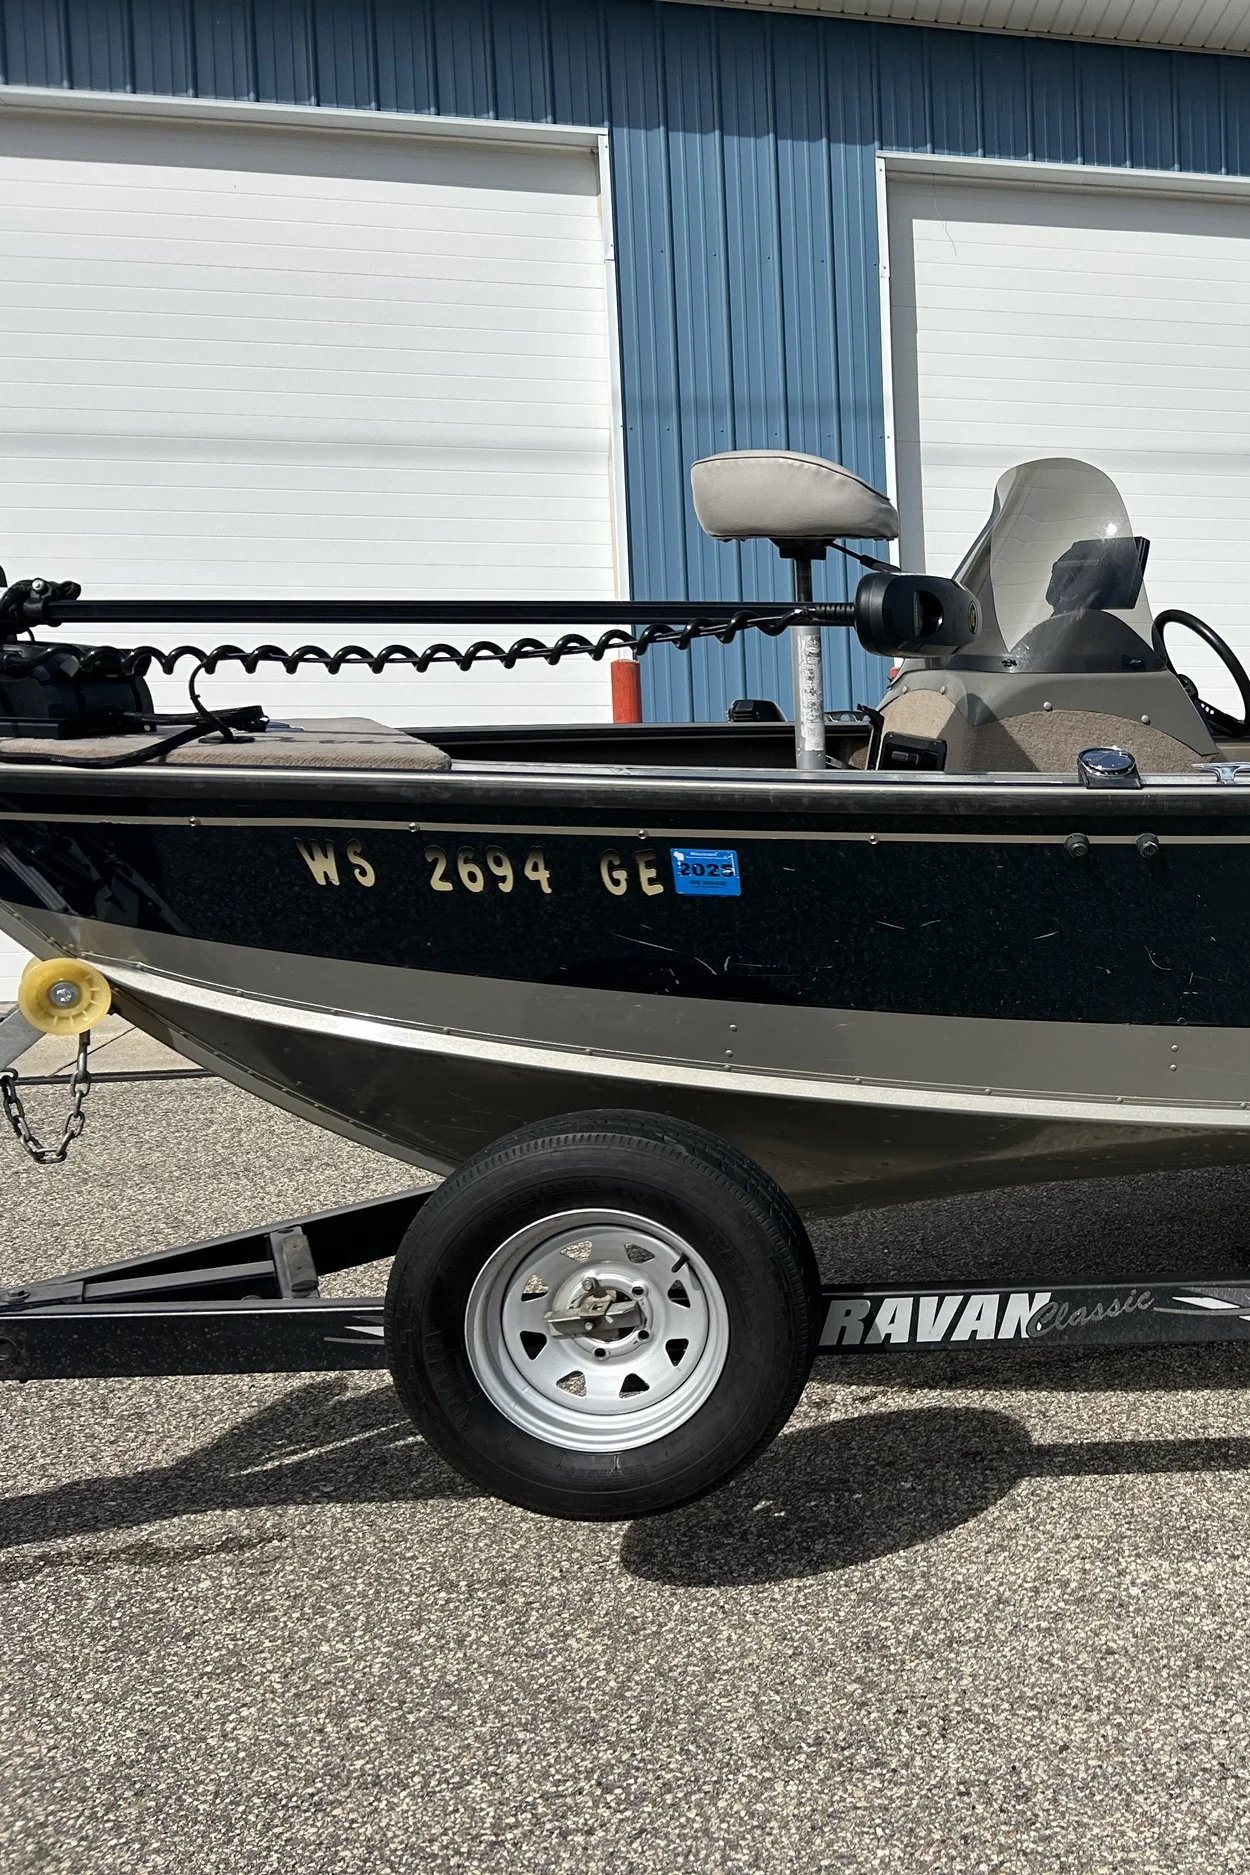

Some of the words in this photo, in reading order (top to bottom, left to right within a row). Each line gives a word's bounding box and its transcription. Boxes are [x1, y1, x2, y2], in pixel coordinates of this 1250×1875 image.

[293, 837, 376, 888] WS
[424, 844, 552, 894] 2694
[600, 848, 665, 896] GE
[818, 1291, 1052, 1346] RAVAN
[1026, 1289, 1155, 1338] Classic
